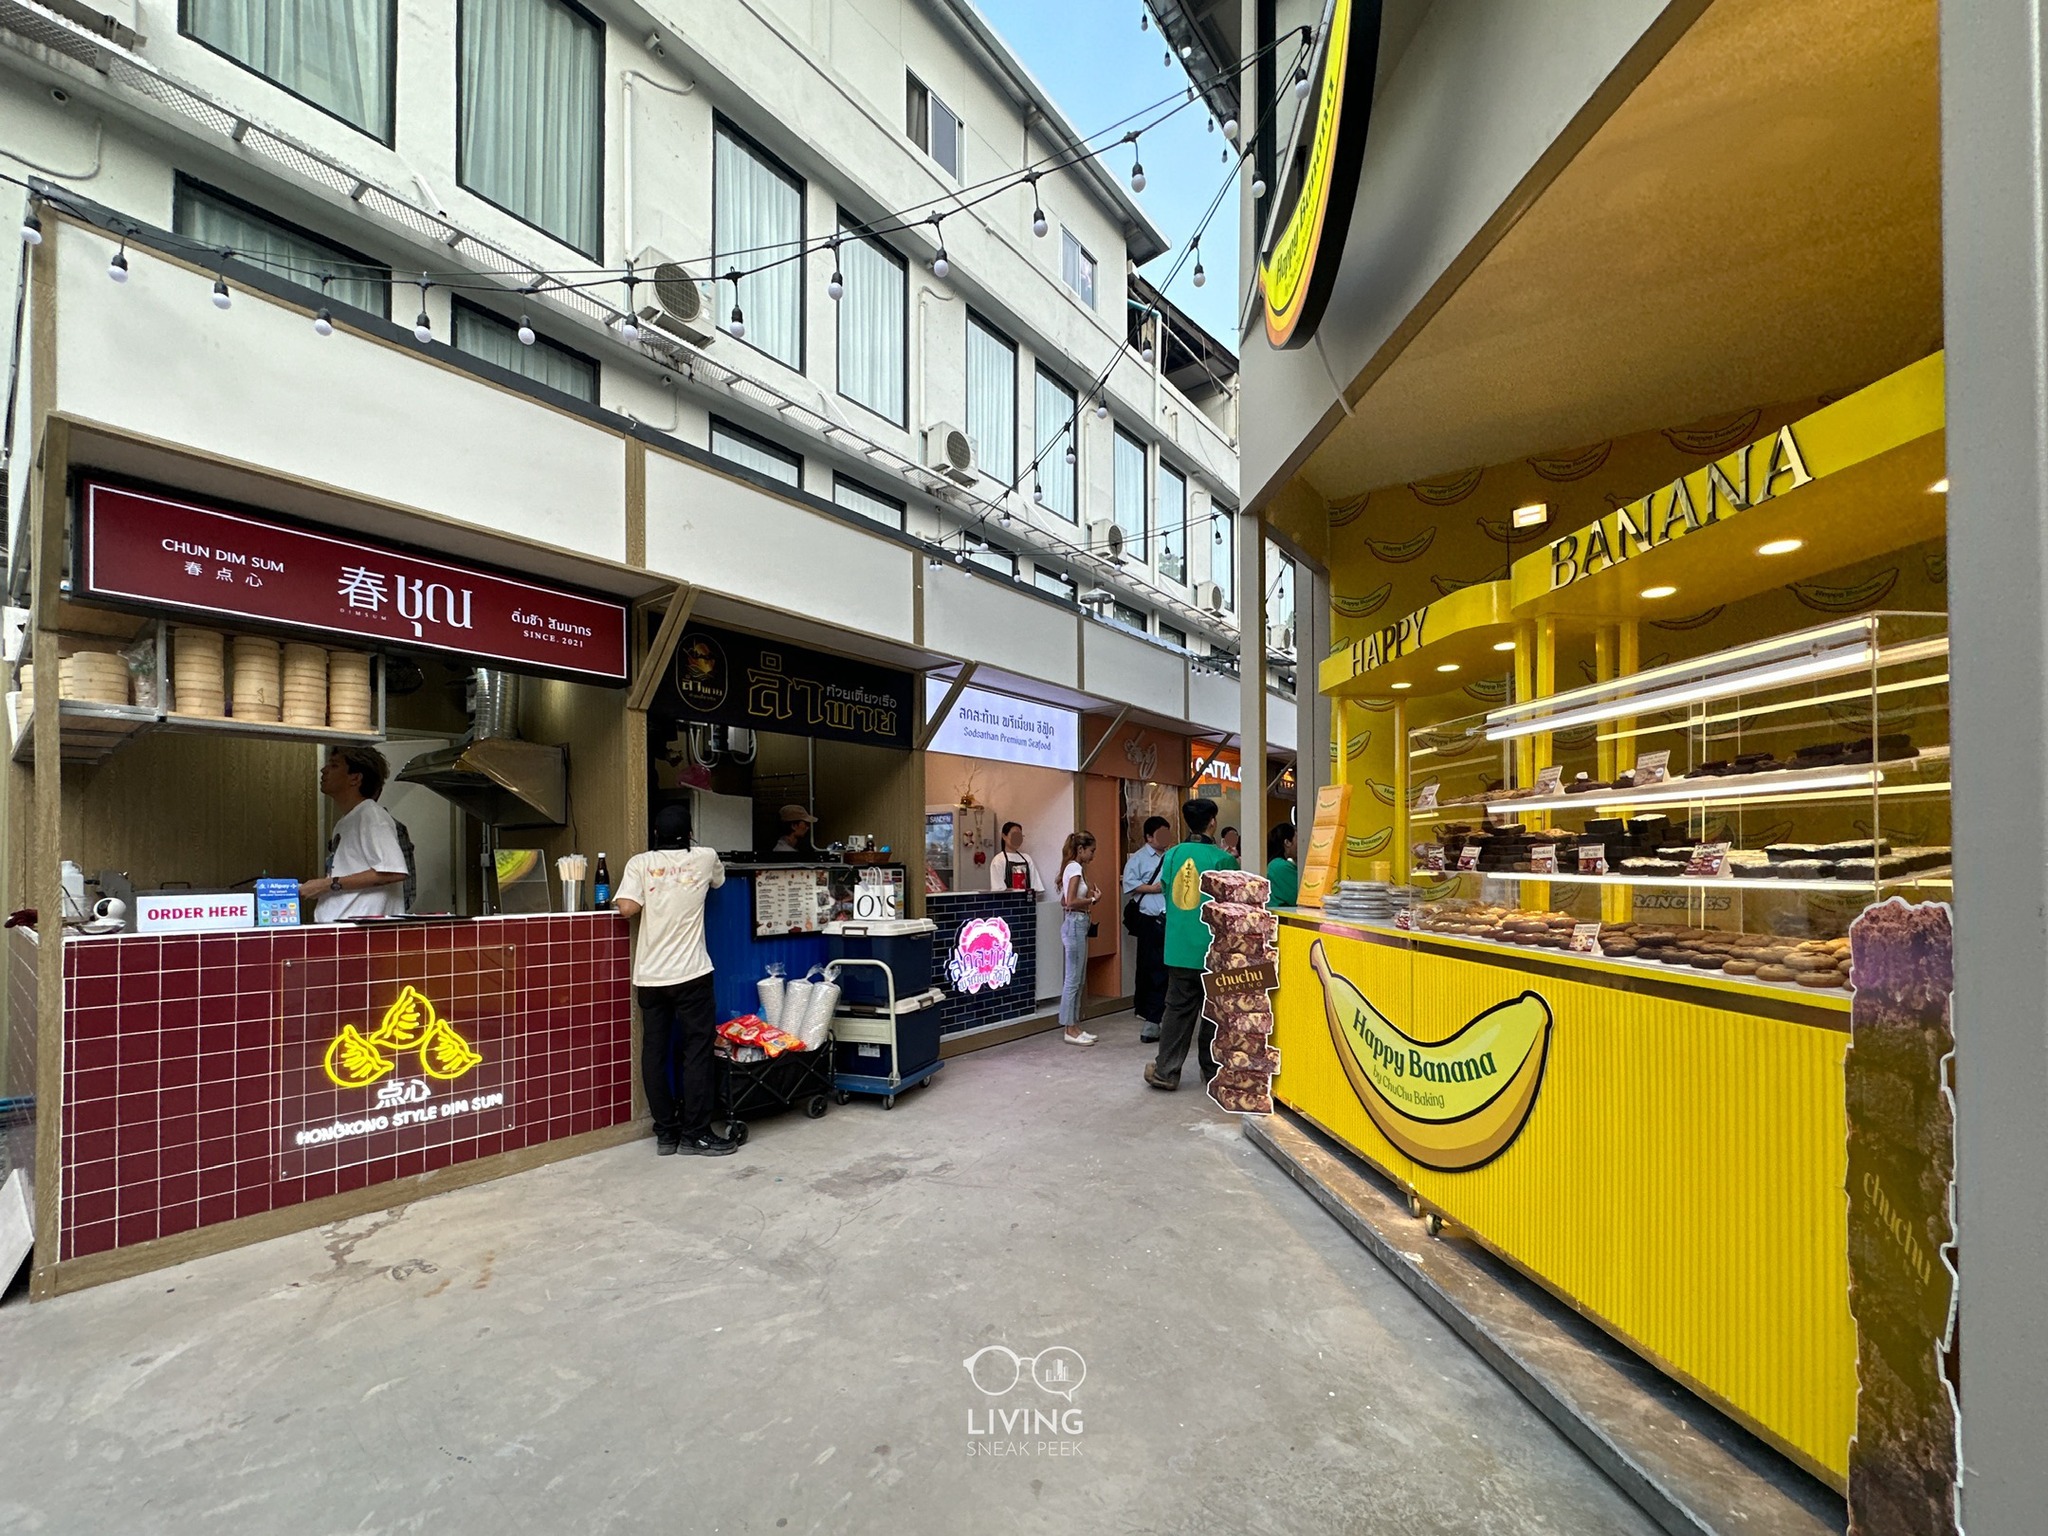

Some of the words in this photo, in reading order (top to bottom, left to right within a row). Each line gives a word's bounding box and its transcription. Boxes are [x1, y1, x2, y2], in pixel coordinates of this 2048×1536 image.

[1549, 424, 1815, 591] BANANA
[162, 538, 210, 558] CHUN
[215, 549, 246, 565] DIM
[251, 557, 284, 573] SUM
[337, 566, 388, 612] 春
[562, 637, 583, 648] 2021
[1350, 606, 1429, 679] HAPPY
[963, 727, 999, 742] Sodsathan
[1000, 733, 1027, 747] Premium
[1028, 738, 1051, 751] Seafood
[147, 906, 204, 921] ORDER
[208, 905, 248, 918] HERE
[1215, 969, 1263, 987] chuchu
[1220, 982, 1262, 993] BAKING
[1352, 1008, 1405, 1078] Happy
[1408, 1049, 1497, 1083] Banana
[1373, 1065, 1382, 1084] by
[1382, 1076, 1413, 1103] ChuChu
[1413, 1091, 1445, 1109] Baking
[296, 1115, 388, 1145] HONGKONG
[392, 1106, 438, 1126] STYLE
[441, 1101, 469, 1117] DIM
[471, 1093, 504, 1111] SUM
[1863, 1172, 1931, 1287] chuchu
